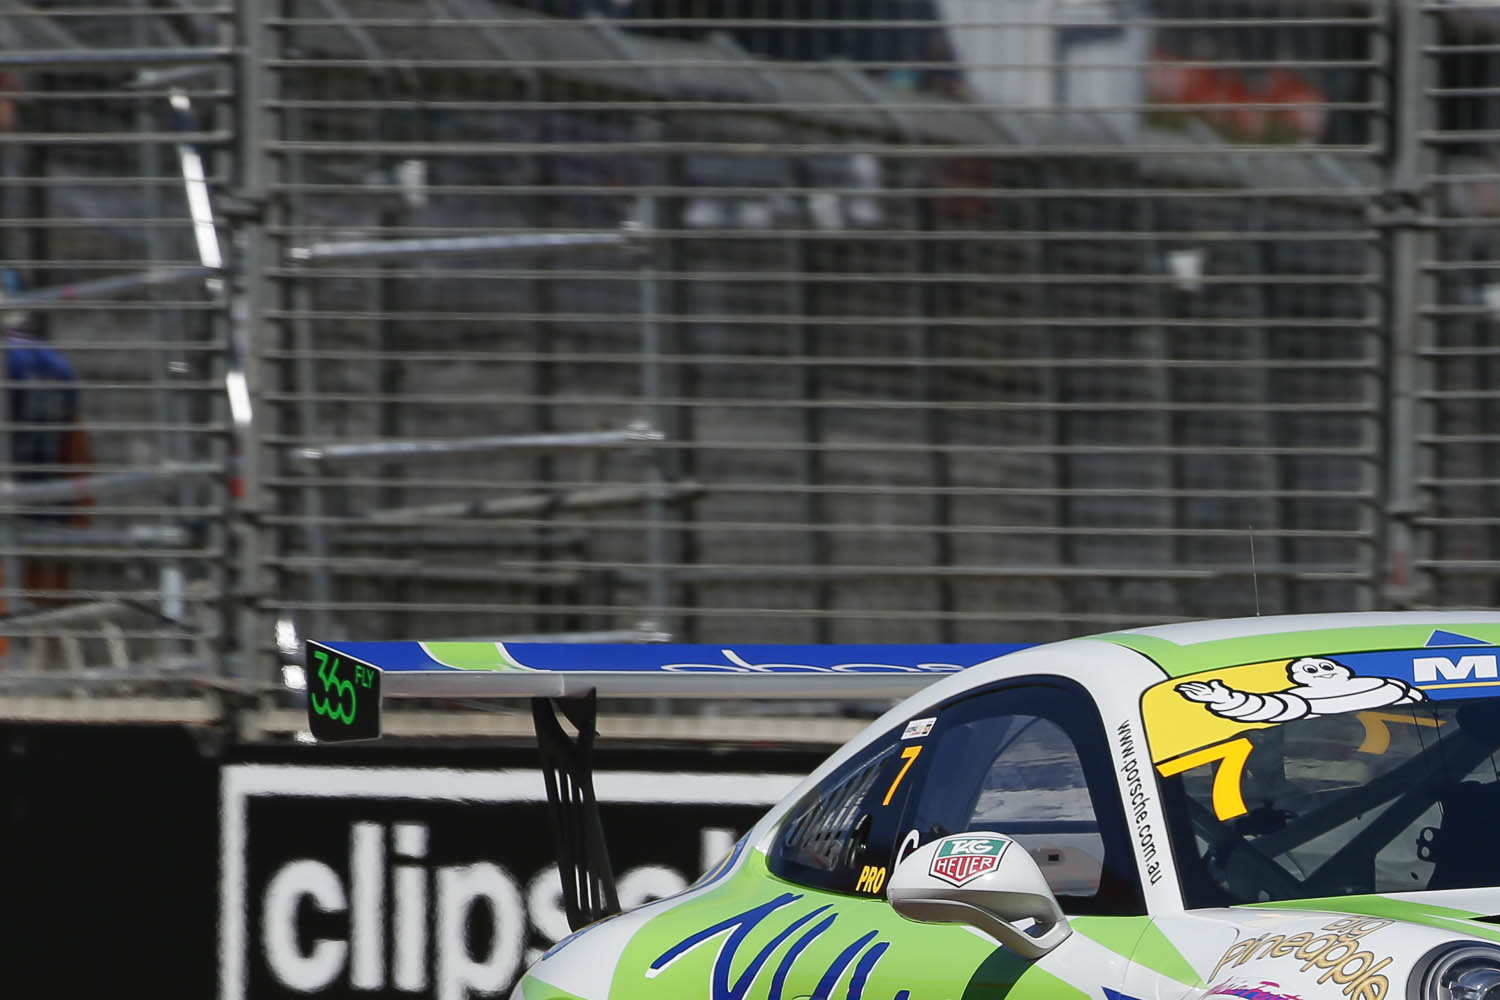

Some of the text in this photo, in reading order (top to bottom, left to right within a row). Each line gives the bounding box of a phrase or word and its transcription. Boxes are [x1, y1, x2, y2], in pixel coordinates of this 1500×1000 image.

[355, 665, 374, 688] FLY
[883, 745, 922, 806] 7
[1155, 737, 1254, 822] 7
[1117, 719, 1163, 885] www.porsche.com.au
[950, 839, 994, 854] TAG
[856, 866, 886, 894] PRO
[936, 855, 993, 880] HEUER
